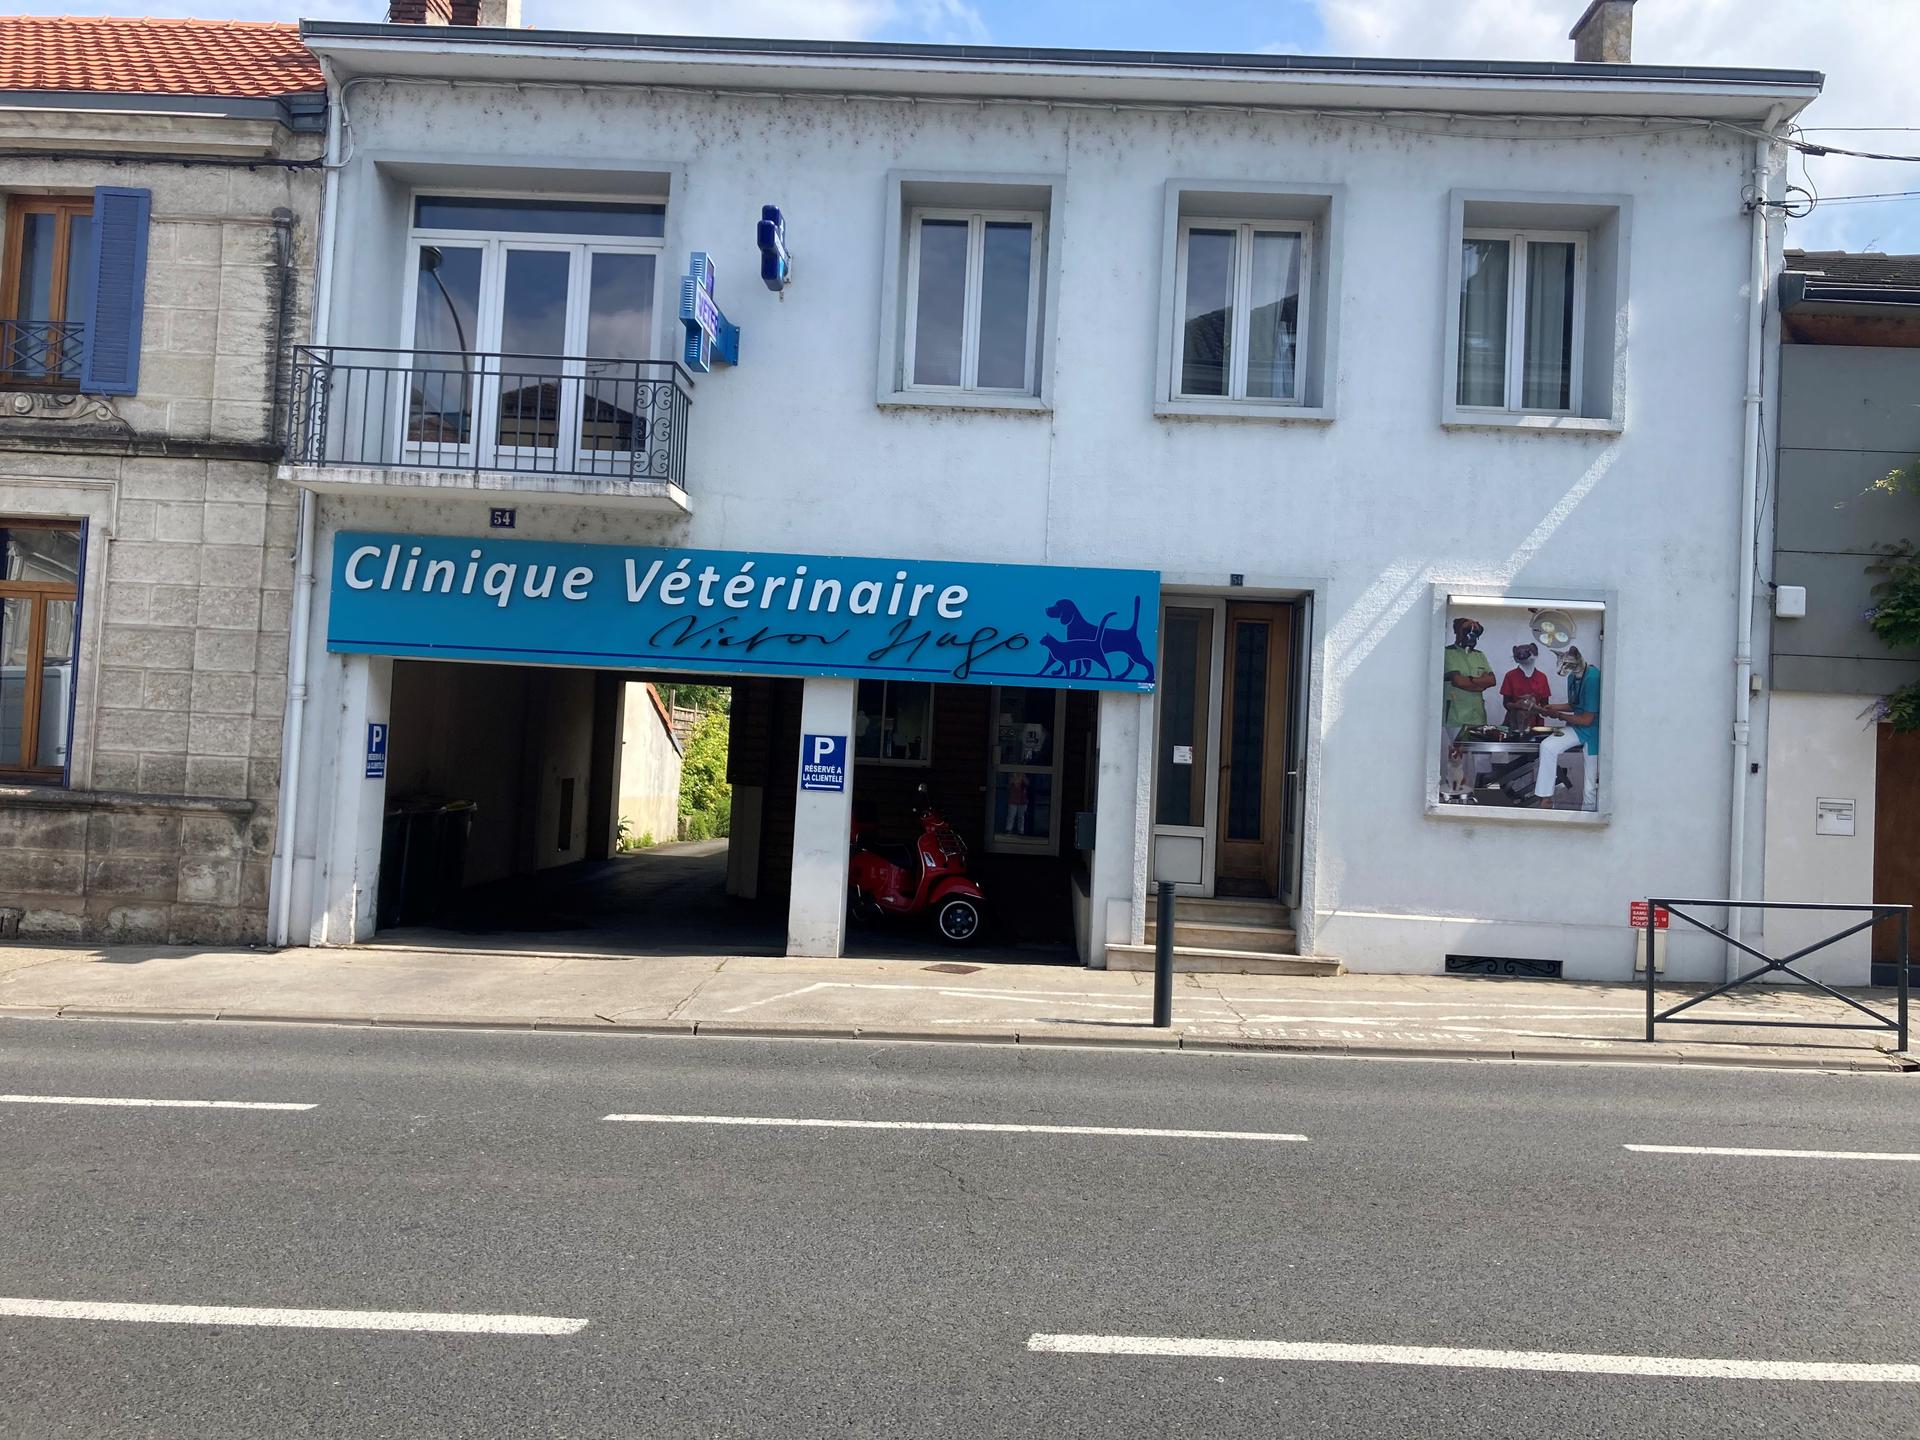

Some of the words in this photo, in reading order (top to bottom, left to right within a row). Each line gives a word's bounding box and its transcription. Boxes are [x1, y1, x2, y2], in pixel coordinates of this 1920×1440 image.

[494, 511, 511, 525] 54
[344, 544, 594, 608] Clinique
[624, 558, 969, 619] Vétérinaire
[648, 614, 850, 653] Victor
[867, 617, 1030, 680] Hugo
[372, 725, 382, 752] P
[814, 736, 835, 764] P
[802, 773, 811, 781] LA
